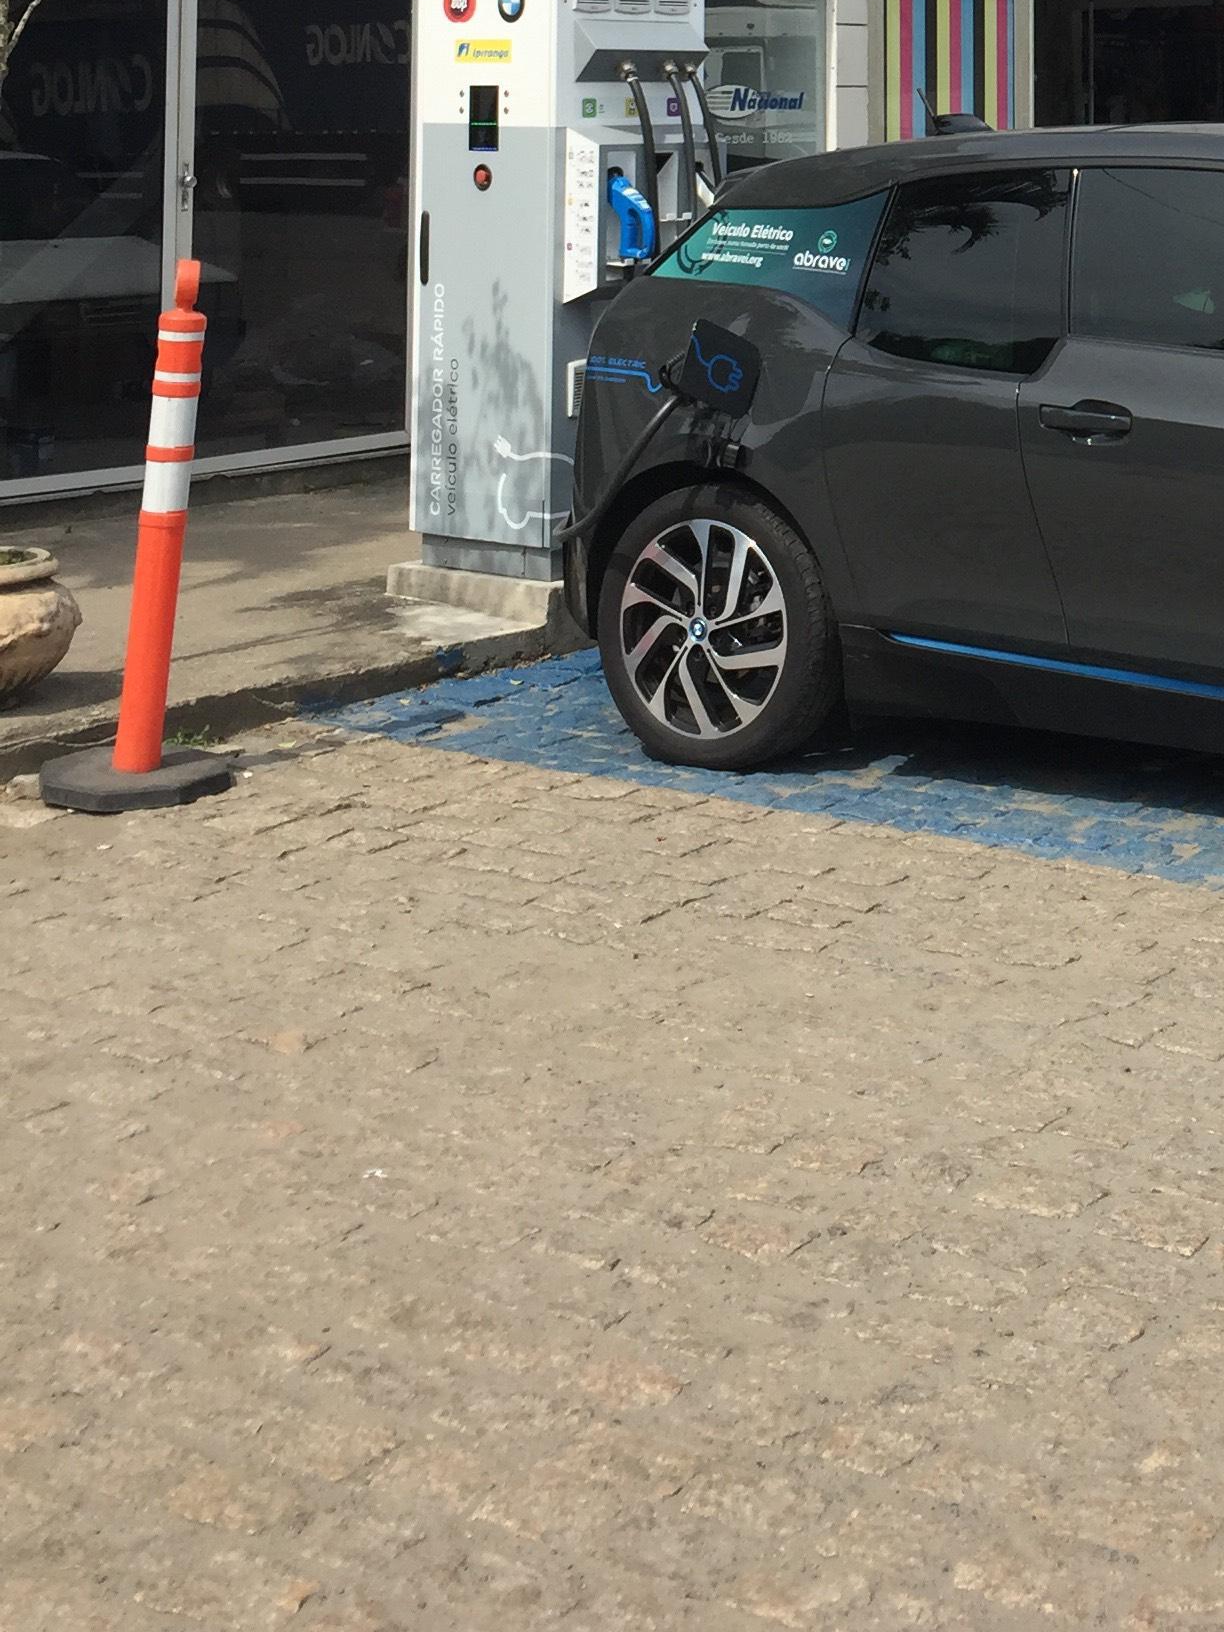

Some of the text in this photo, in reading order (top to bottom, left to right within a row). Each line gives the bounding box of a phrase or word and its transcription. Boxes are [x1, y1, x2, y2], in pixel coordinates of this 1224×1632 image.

[711, 221, 794, 242] Veículo Elétrico
[429, 282, 445, 516] CARREGADOR RÁPIDO
[444, 358, 460, 516] veículo elétrico
